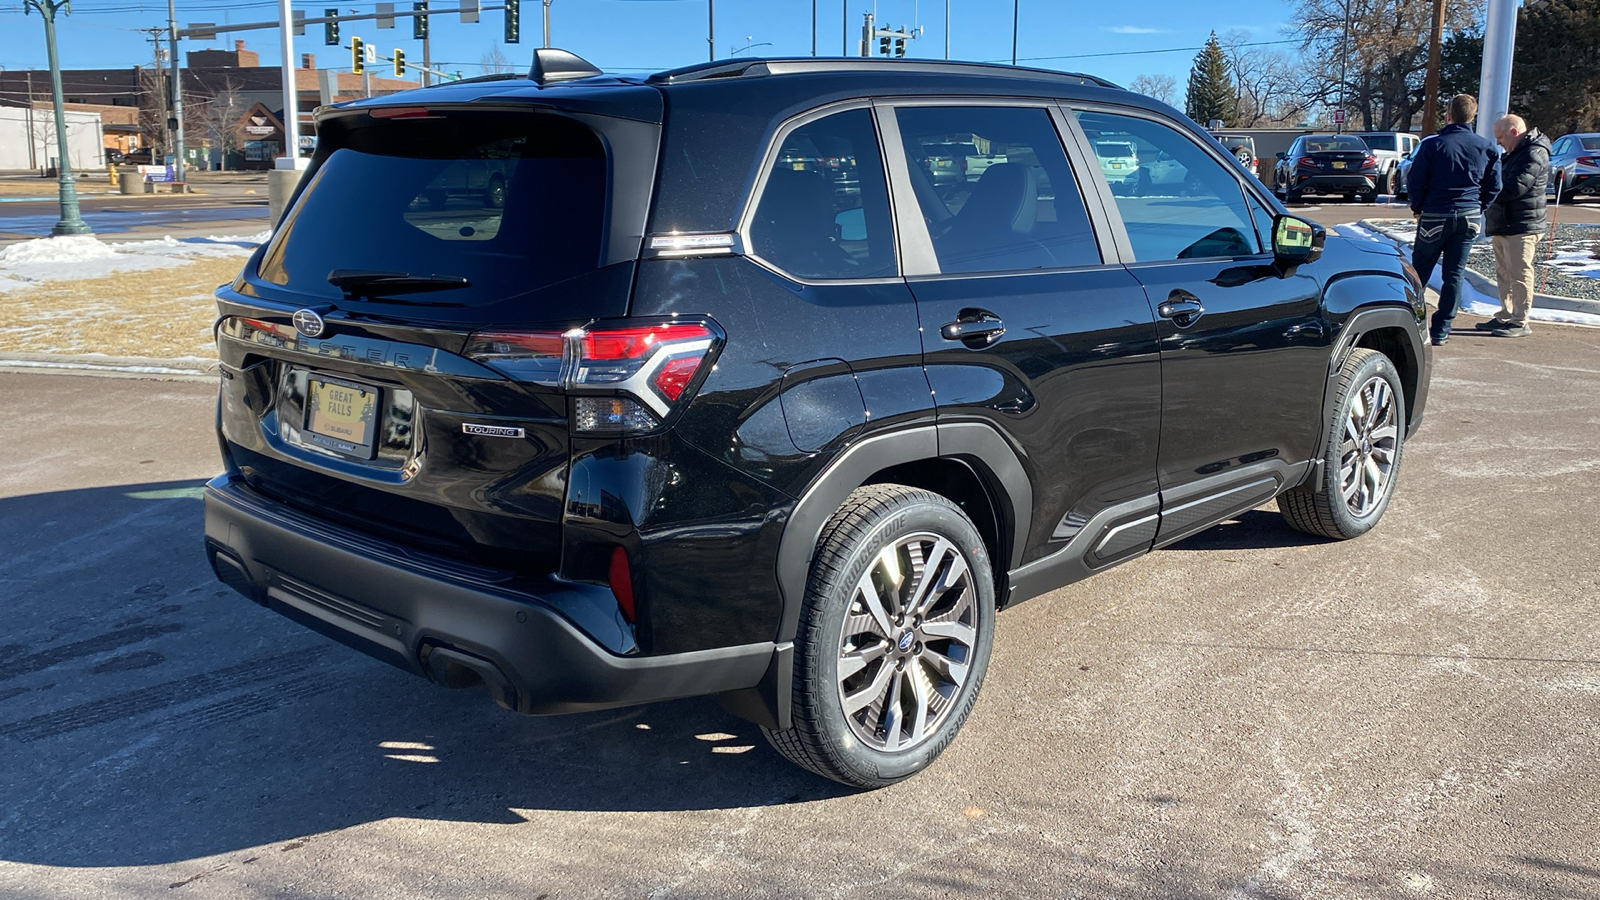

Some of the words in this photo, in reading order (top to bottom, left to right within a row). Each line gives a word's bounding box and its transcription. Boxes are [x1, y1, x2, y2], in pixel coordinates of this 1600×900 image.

[329, 389, 354, 404] GREAT
[327, 401, 352, 417] FALLS
[330, 425, 353, 436] SUBARU
[468, 426, 515, 436] TOURING
[837, 513, 906, 605] BRIDGESTONE
